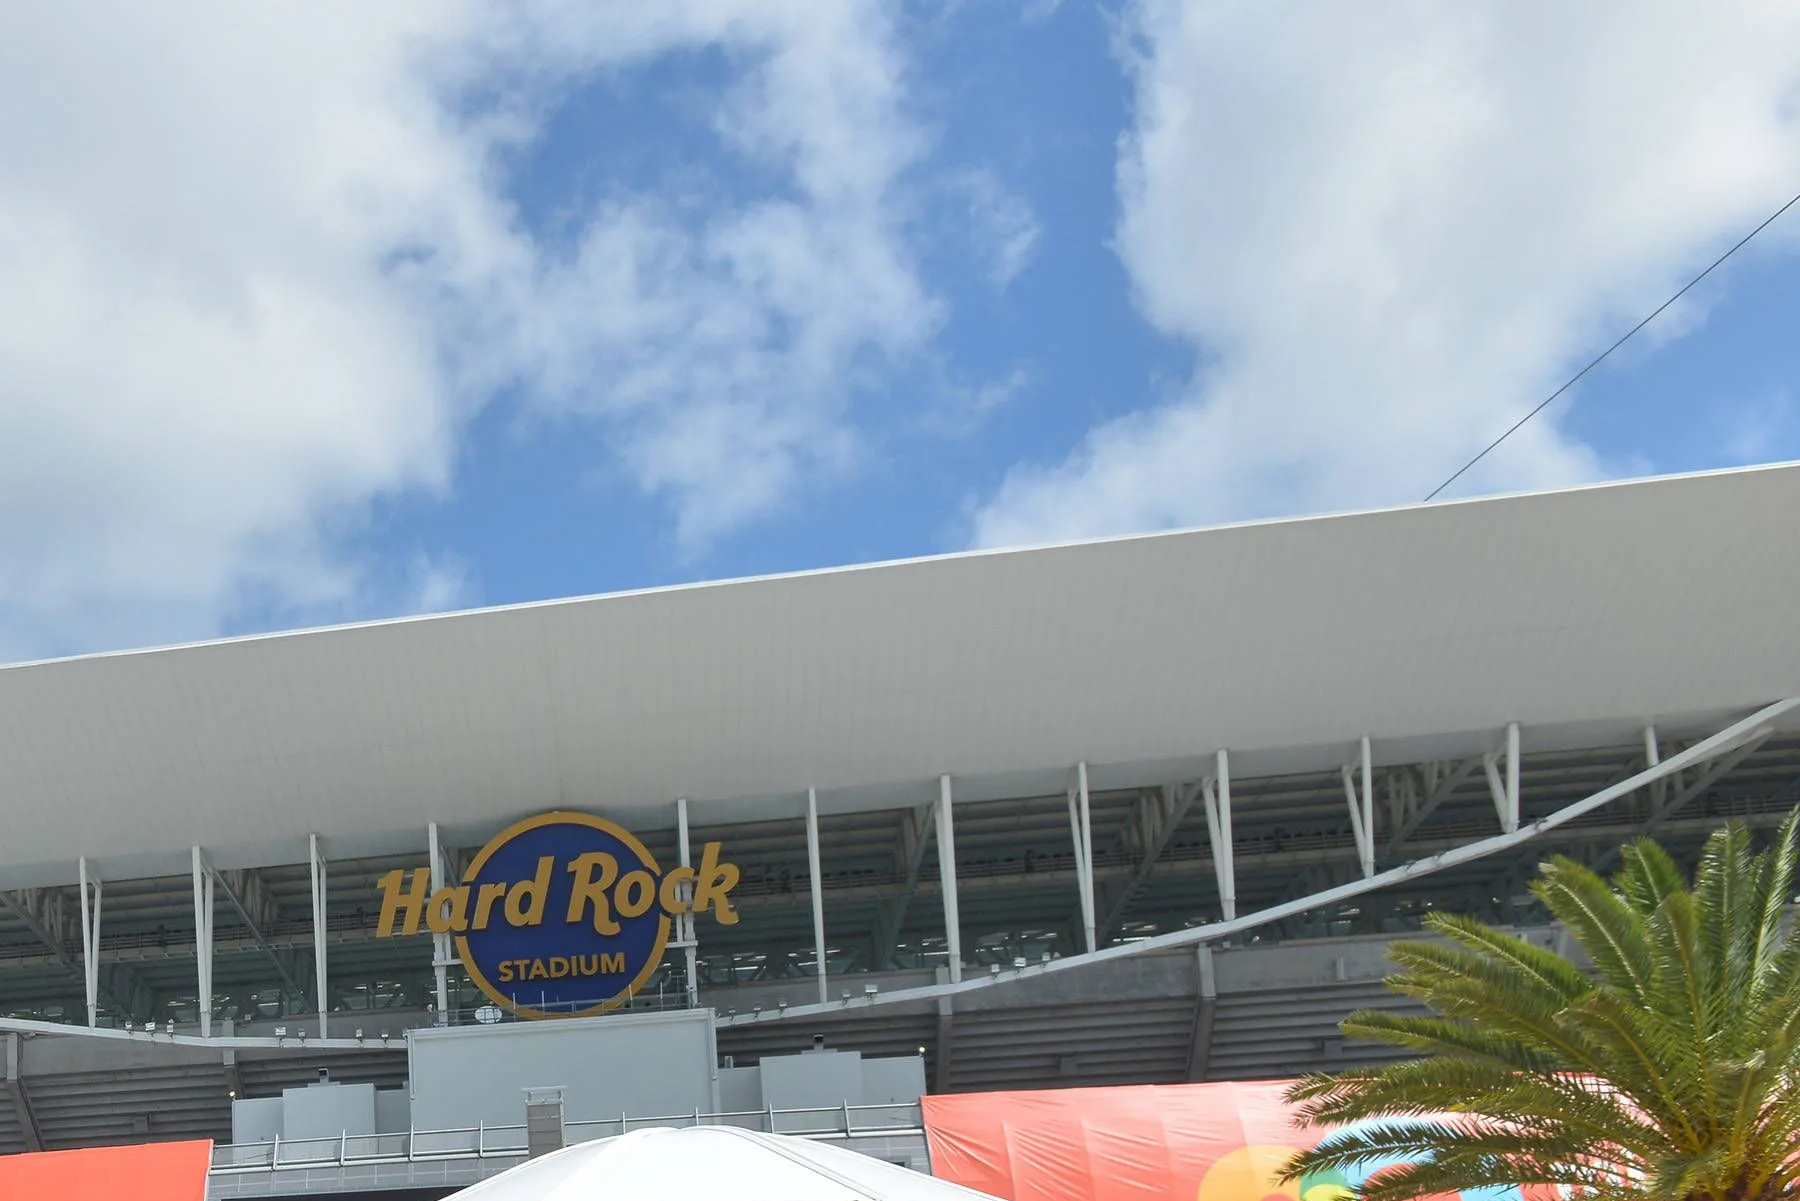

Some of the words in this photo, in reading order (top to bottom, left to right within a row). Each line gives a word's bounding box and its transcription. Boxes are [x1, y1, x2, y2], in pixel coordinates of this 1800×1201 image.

[375, 855, 555, 938] Hard
[566, 841, 741, 937] Rock
[498, 951, 627, 983] STADIUM
